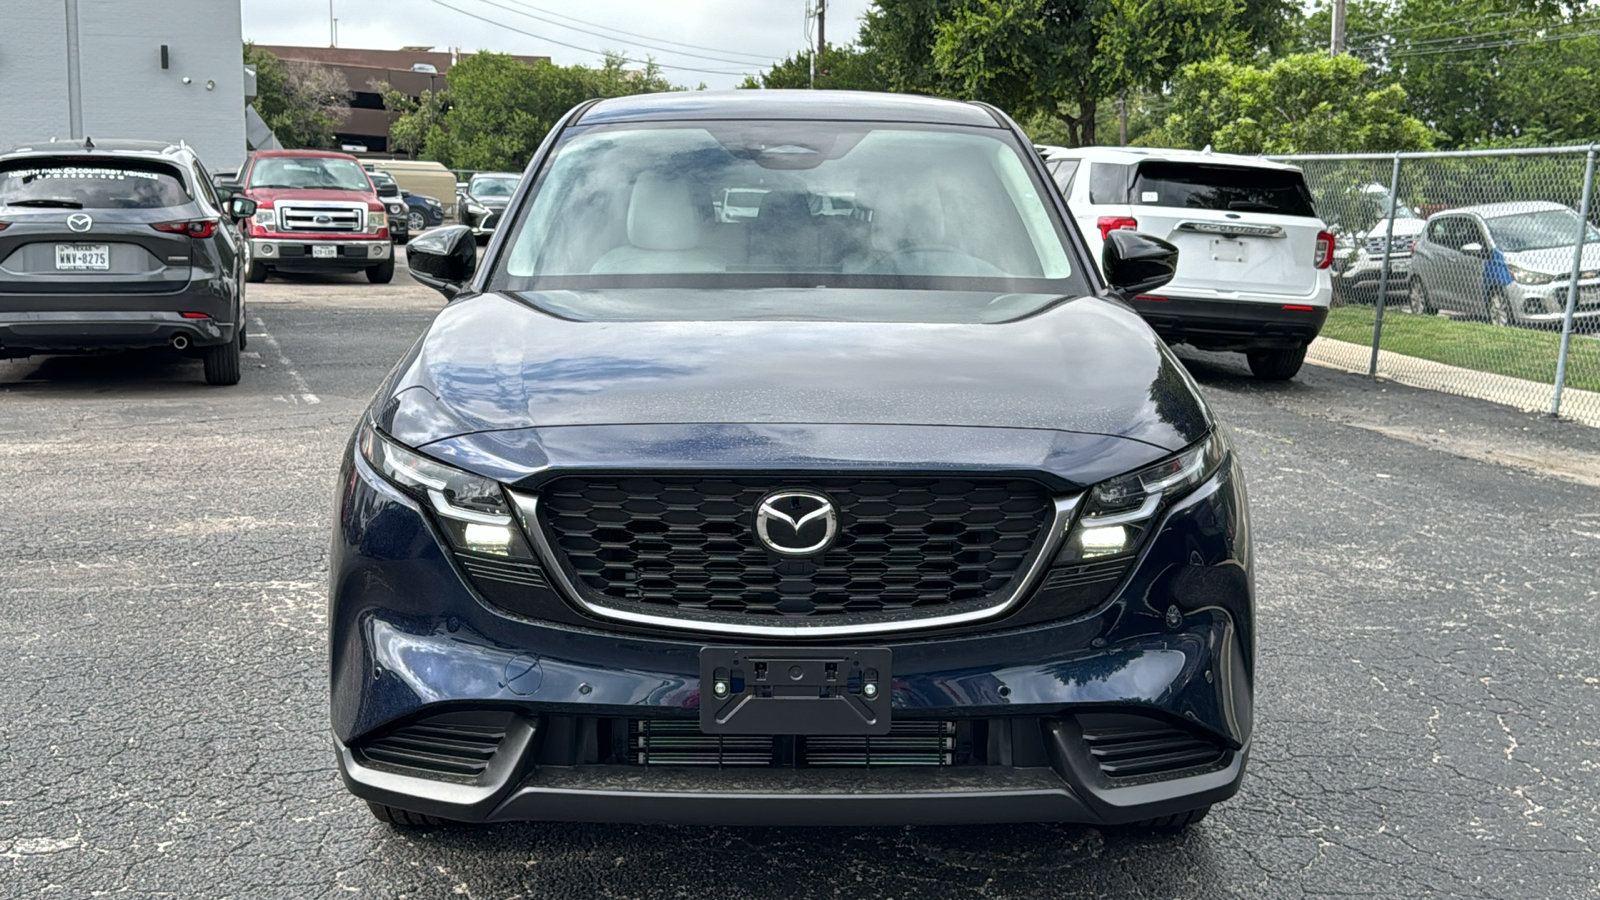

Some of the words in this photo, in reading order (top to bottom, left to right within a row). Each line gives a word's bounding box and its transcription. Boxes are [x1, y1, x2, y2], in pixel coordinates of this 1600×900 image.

[8, 168, 40, 179] NORTH
[41, 167, 63, 175] PARK
[77, 167, 122, 177] COURTESY
[123, 169, 159, 181] VEHICLE
